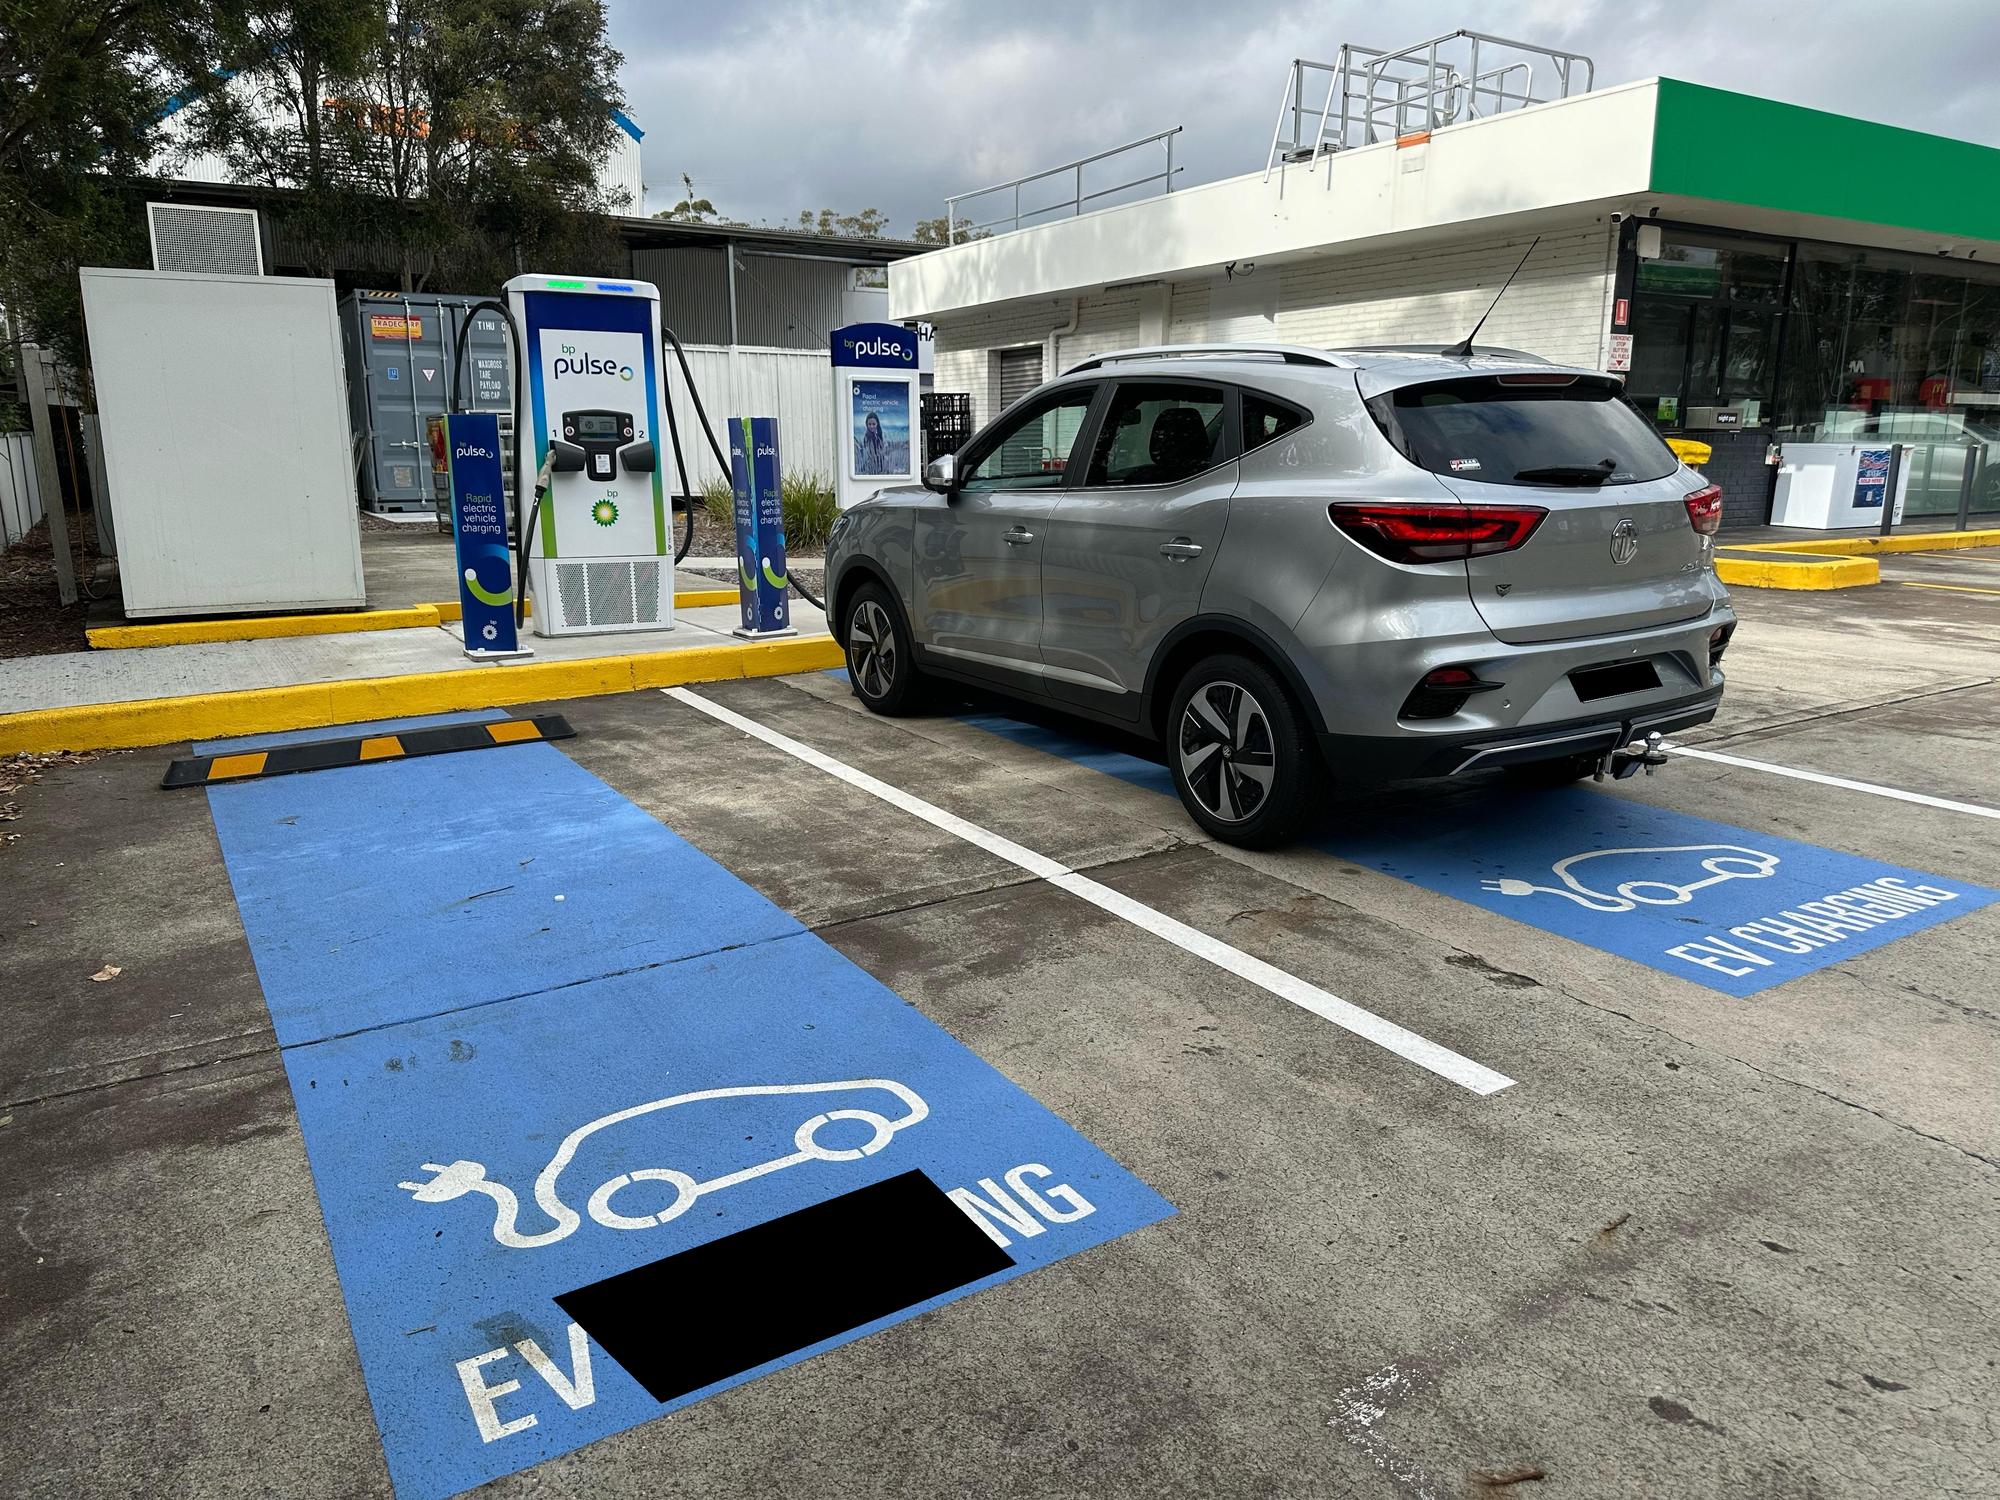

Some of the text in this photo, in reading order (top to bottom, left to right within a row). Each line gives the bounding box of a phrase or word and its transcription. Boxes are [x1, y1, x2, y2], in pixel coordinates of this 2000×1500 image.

[477, 321, 495, 330] TIHU
[561, 343, 576, 356] bp
[844, 336, 901, 360] bp pulse
[554, 352, 617, 380] pulse
[552, 429, 557, 438] 1
[638, 430, 645, 438] 2
[457, 445, 486, 459] pulse
[466, 493, 492, 504] Rapid
[607, 489, 618, 498] bp
[462, 503, 497, 513] electric
[464, 513, 497, 523] vehicle
[462, 523, 501, 534] charging
[1664, 877, 1960, 977] EV CHARGING
[455, 1322, 597, 1443] EV
